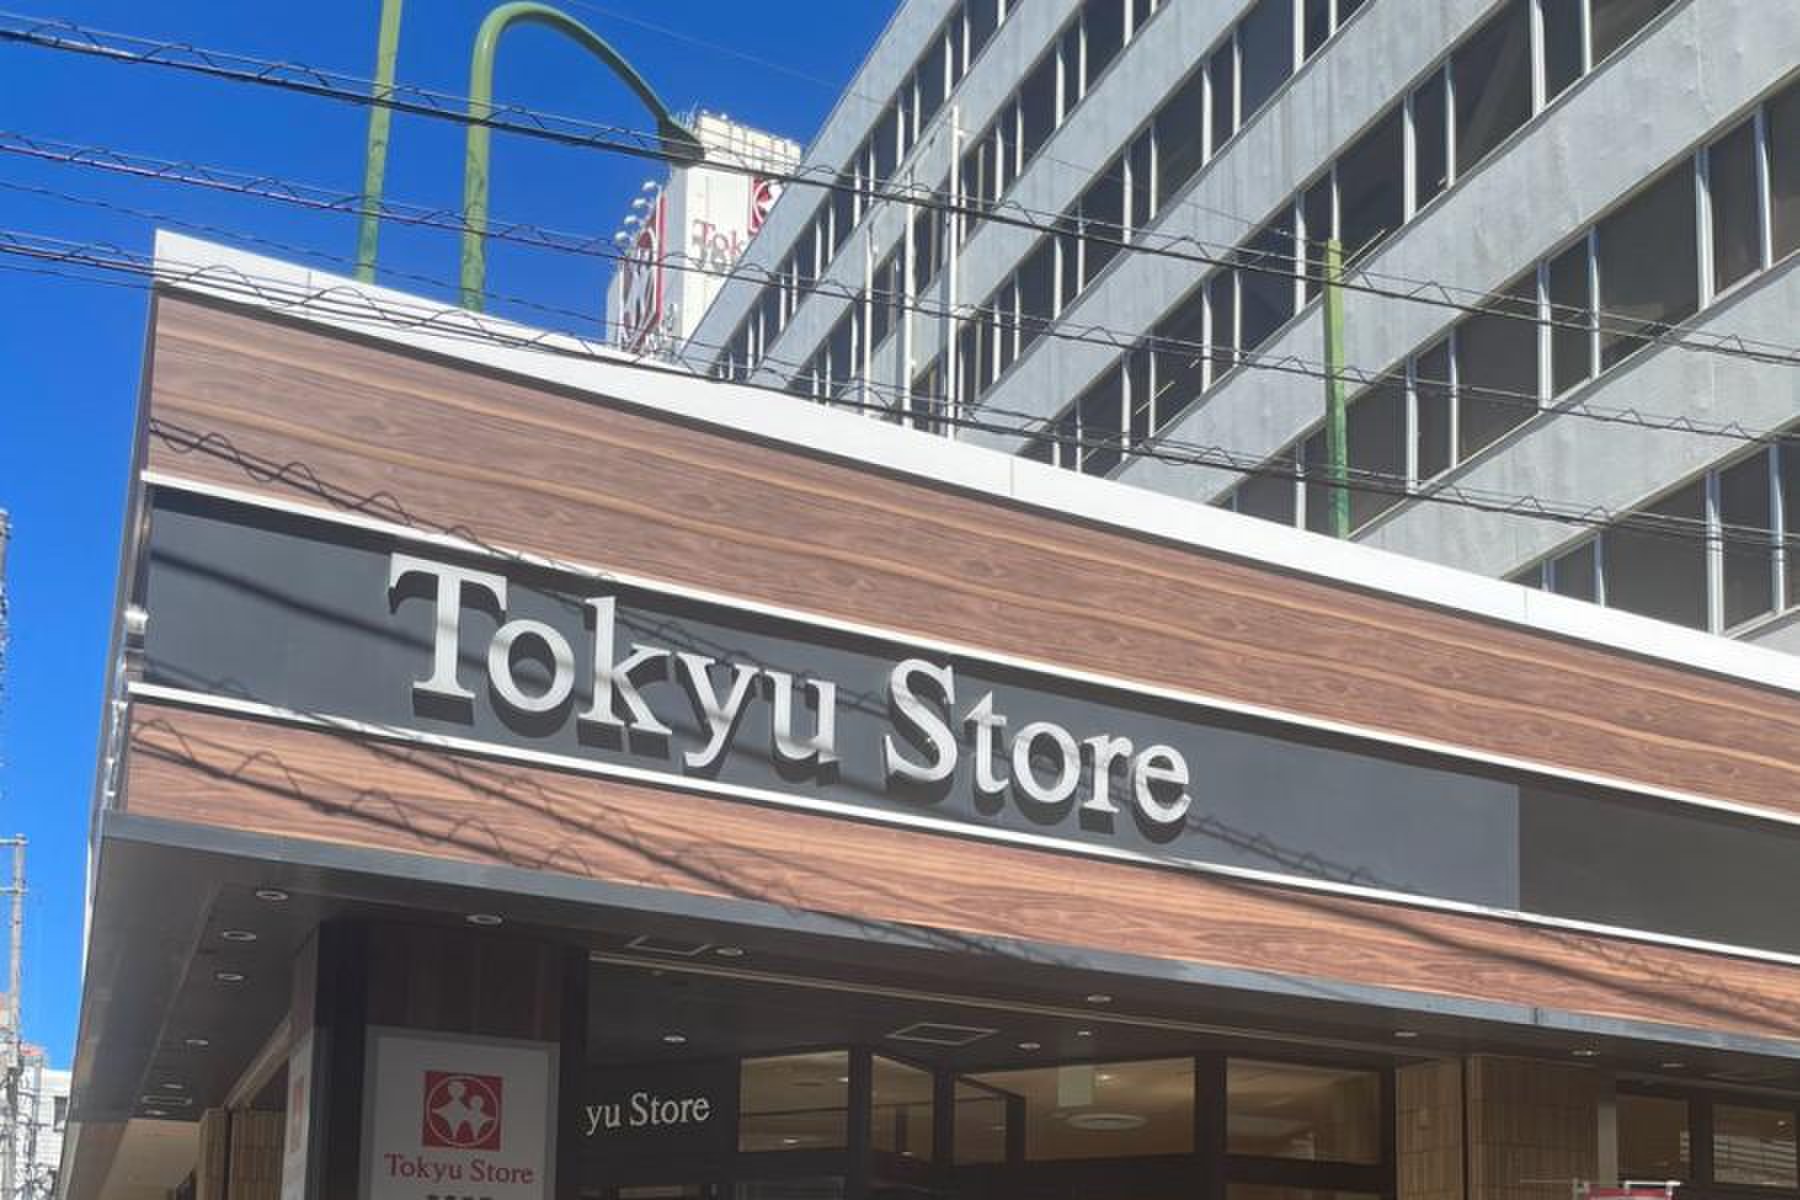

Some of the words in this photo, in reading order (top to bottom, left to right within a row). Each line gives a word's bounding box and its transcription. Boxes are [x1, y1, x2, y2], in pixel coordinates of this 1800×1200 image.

[388, 551, 838, 769] Tokyu
[882, 655, 1193, 823] Store
[629, 1092, 711, 1126] Store
[384, 1152, 462, 1183] Tokyu
[469, 1158, 535, 1184] Store
